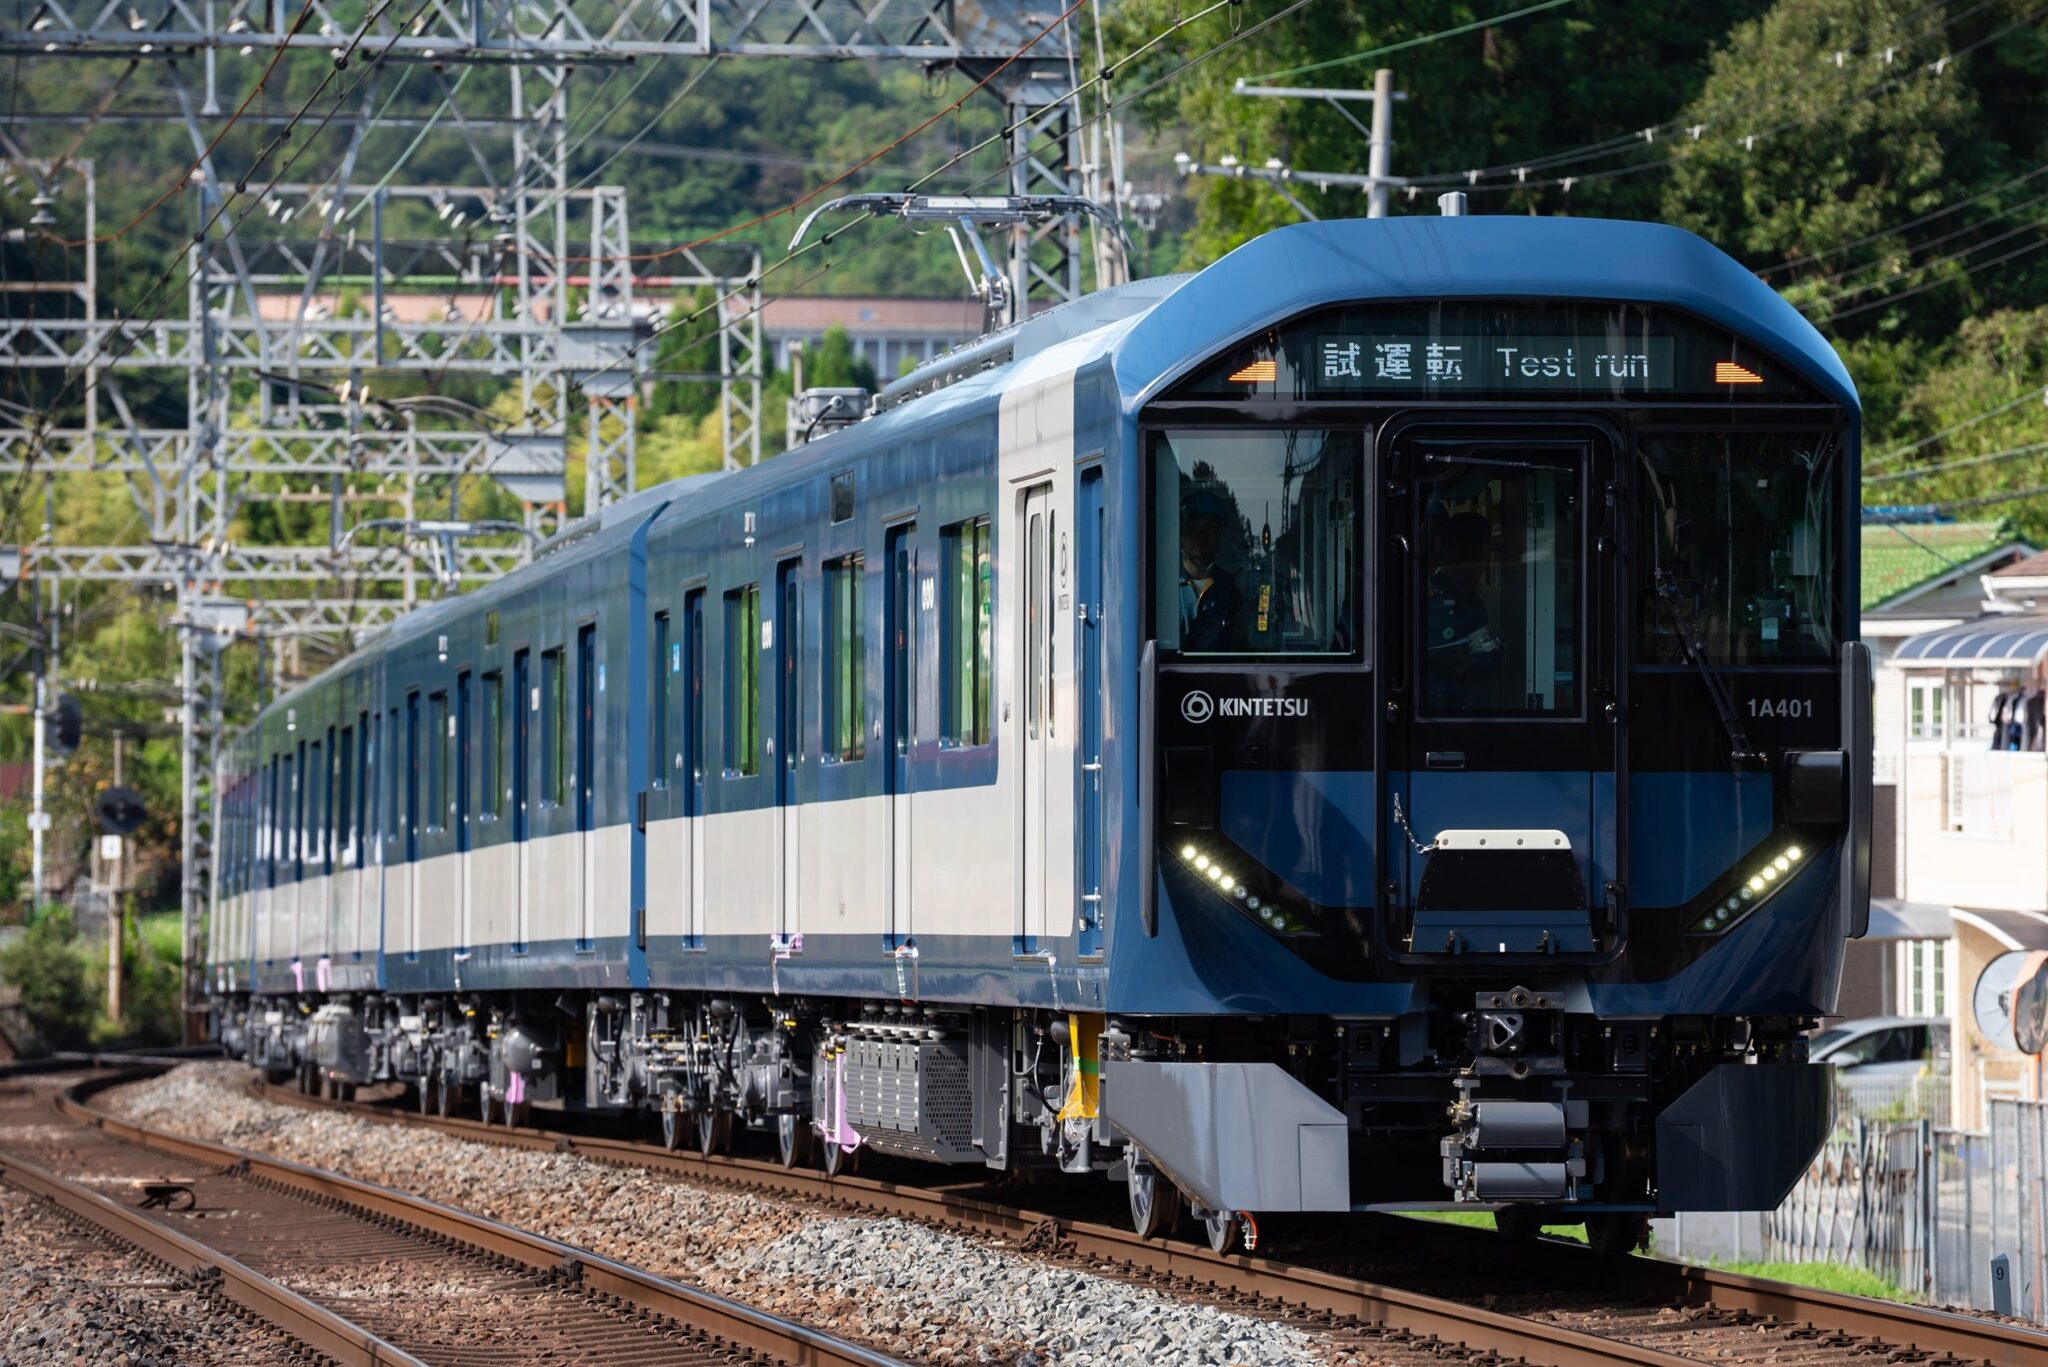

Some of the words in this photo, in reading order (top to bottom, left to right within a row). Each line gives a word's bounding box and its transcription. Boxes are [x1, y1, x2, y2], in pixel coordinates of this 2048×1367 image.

[1324, 343, 1463, 381] 試運転
[1497, 348, 1576, 377] Test
[1595, 355, 1649, 377] run
[1219, 698, 1309, 717] KINTETSU
[1747, 698, 1813, 718] 1A401
[1996, 1266, 2004, 1280] 9
